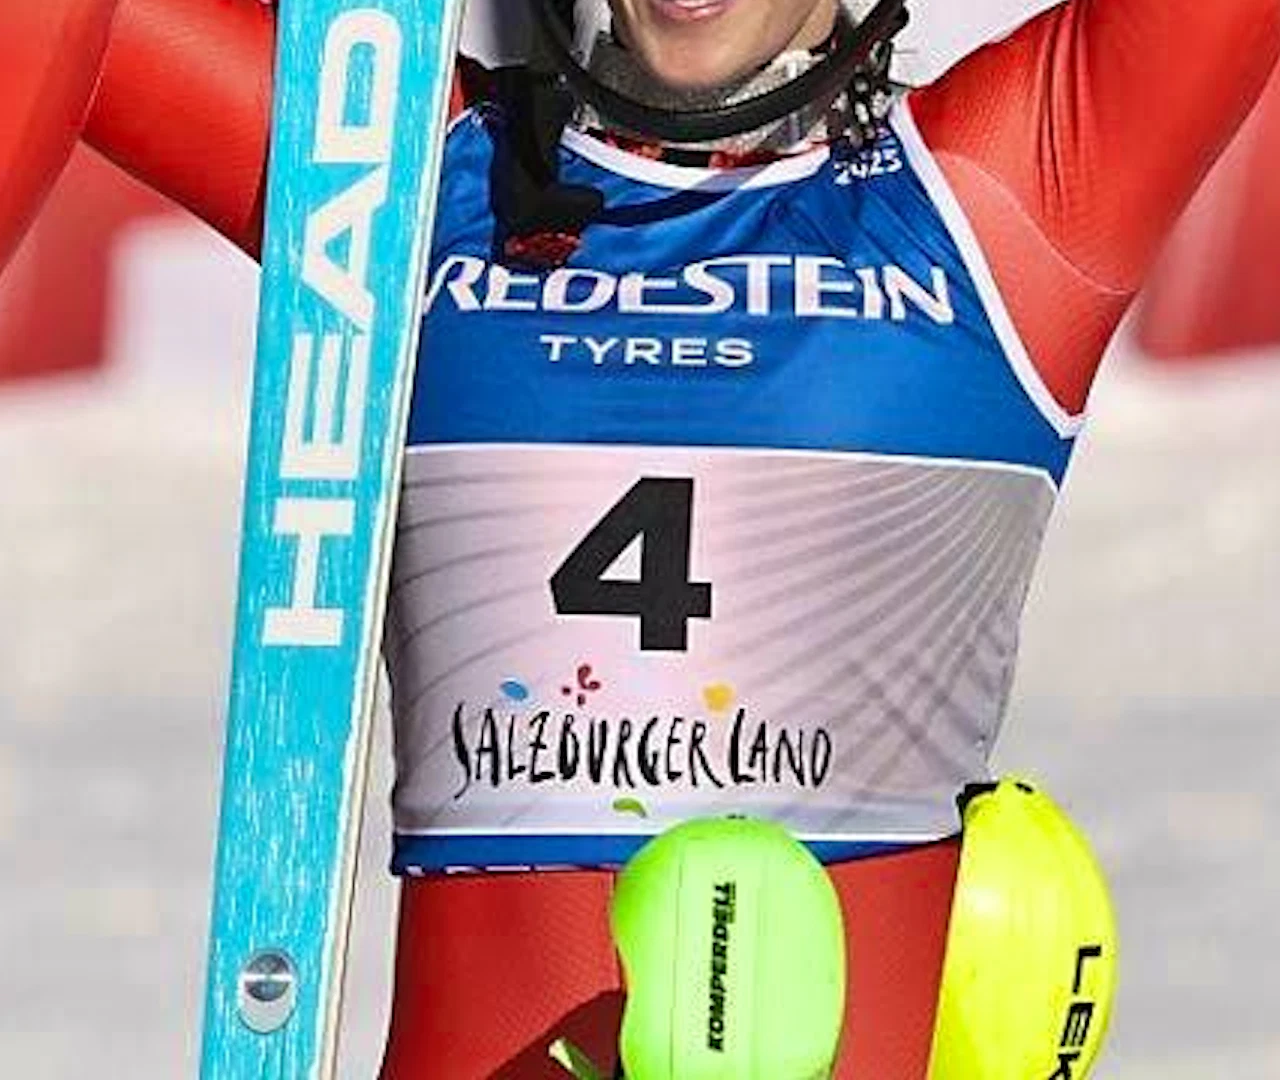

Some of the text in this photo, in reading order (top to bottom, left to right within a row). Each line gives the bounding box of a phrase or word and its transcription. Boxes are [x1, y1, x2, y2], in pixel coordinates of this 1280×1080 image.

[261, 6, 401, 647] HEAD
[422, 254, 954, 325] REDESTEIN
[540, 334, 754, 366] TYRES
[549, 476, 713, 652] 4
